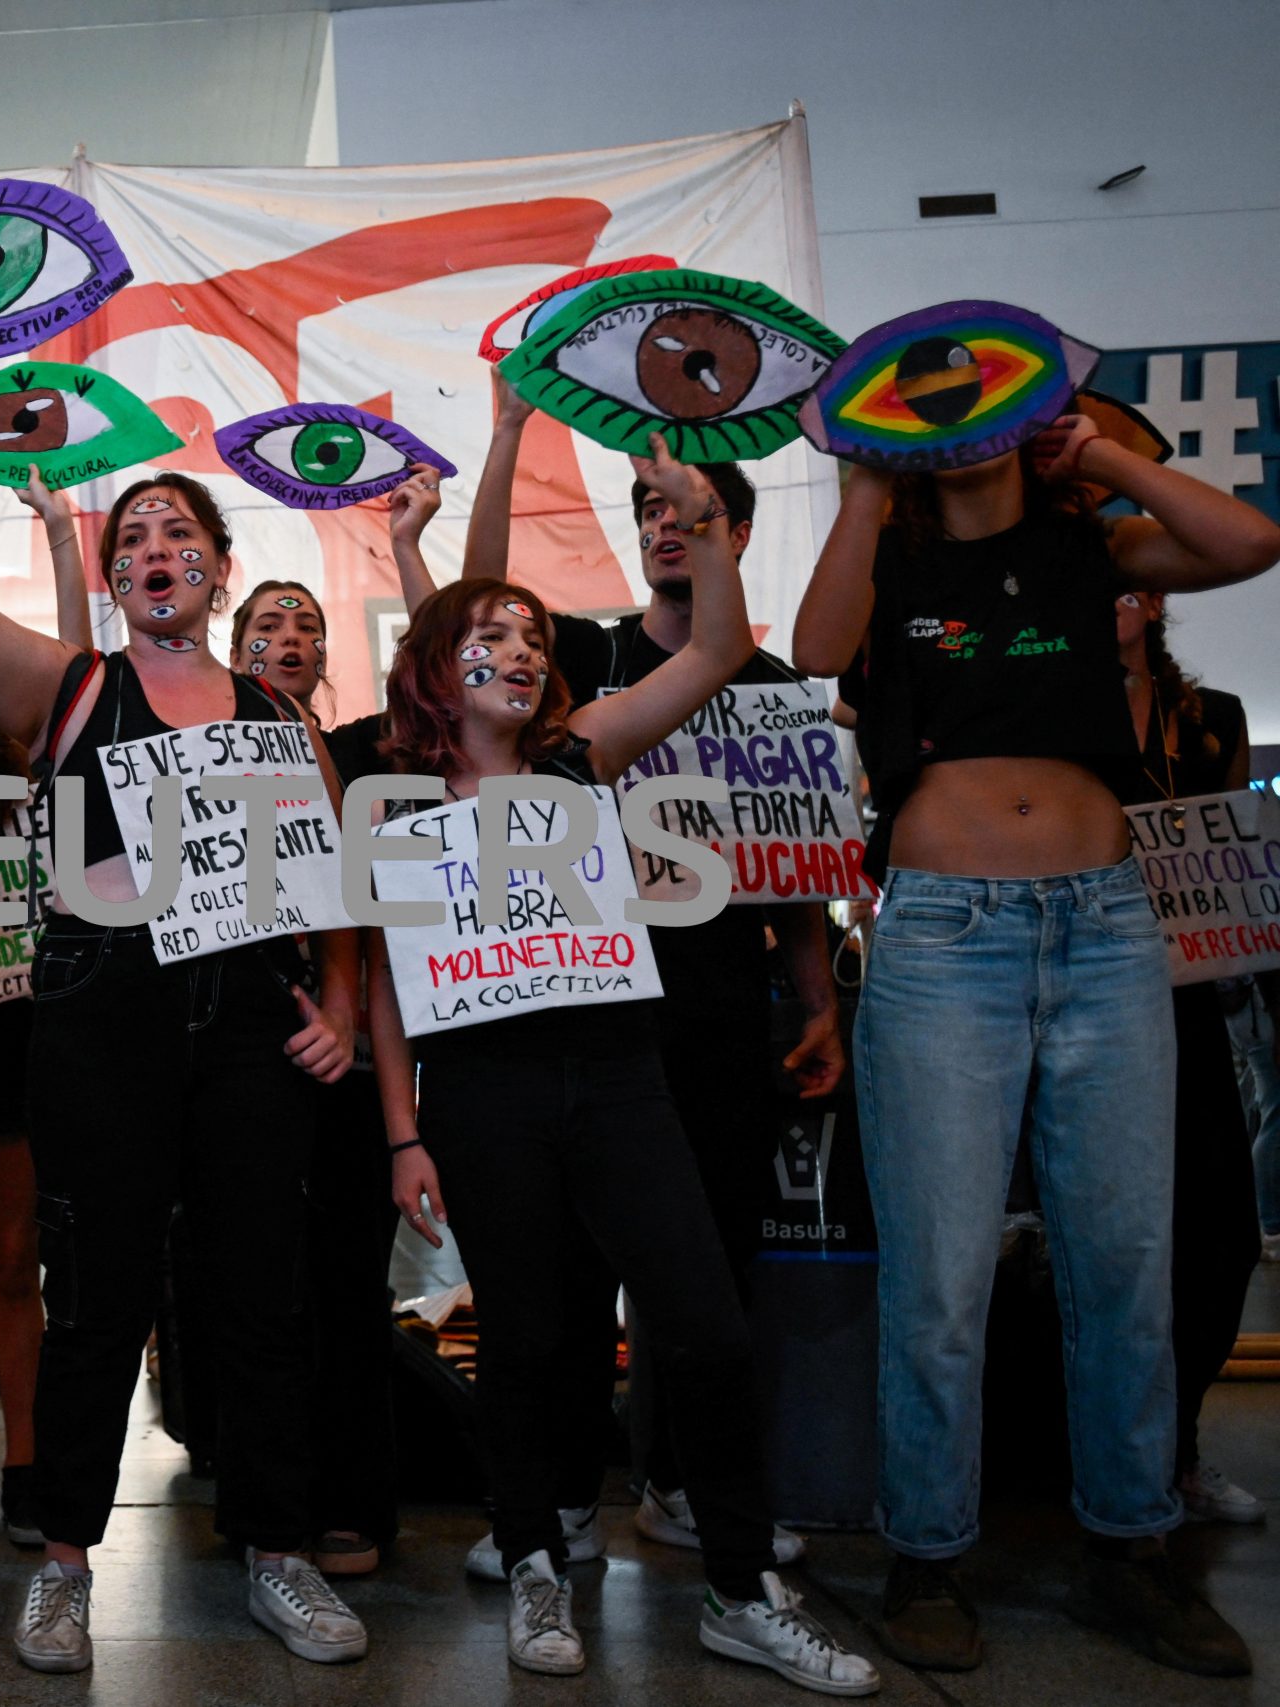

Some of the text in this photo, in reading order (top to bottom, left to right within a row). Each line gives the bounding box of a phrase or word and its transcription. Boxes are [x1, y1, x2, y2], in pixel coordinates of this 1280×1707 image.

[75, 279, 103, 302] RED
[44, 457, 117, 484] CULTURAL
[107, 723, 317, 790] SE VE, SE SIENTE
[473, 799, 557, 843] AY
[730, 791, 841, 837] FORMA
[1200, 802, 1261, 843] EL
[181, 818, 334, 877] RESIENTE
[710, 839, 880, 898] UCHAR
[1144, 841, 1280, 890] OTOCOLO
[191, 878, 286, 914] COLECTA
[453, 888, 574, 936] HBRA
[1147, 886, 1230, 920] RIBA
[161, 927, 200, 957] RED
[428, 932, 635, 988] MOLINETAZO
[432, 974, 633, 1021] LA COLECTIVA
[762, 1219, 846, 1240] Basura
